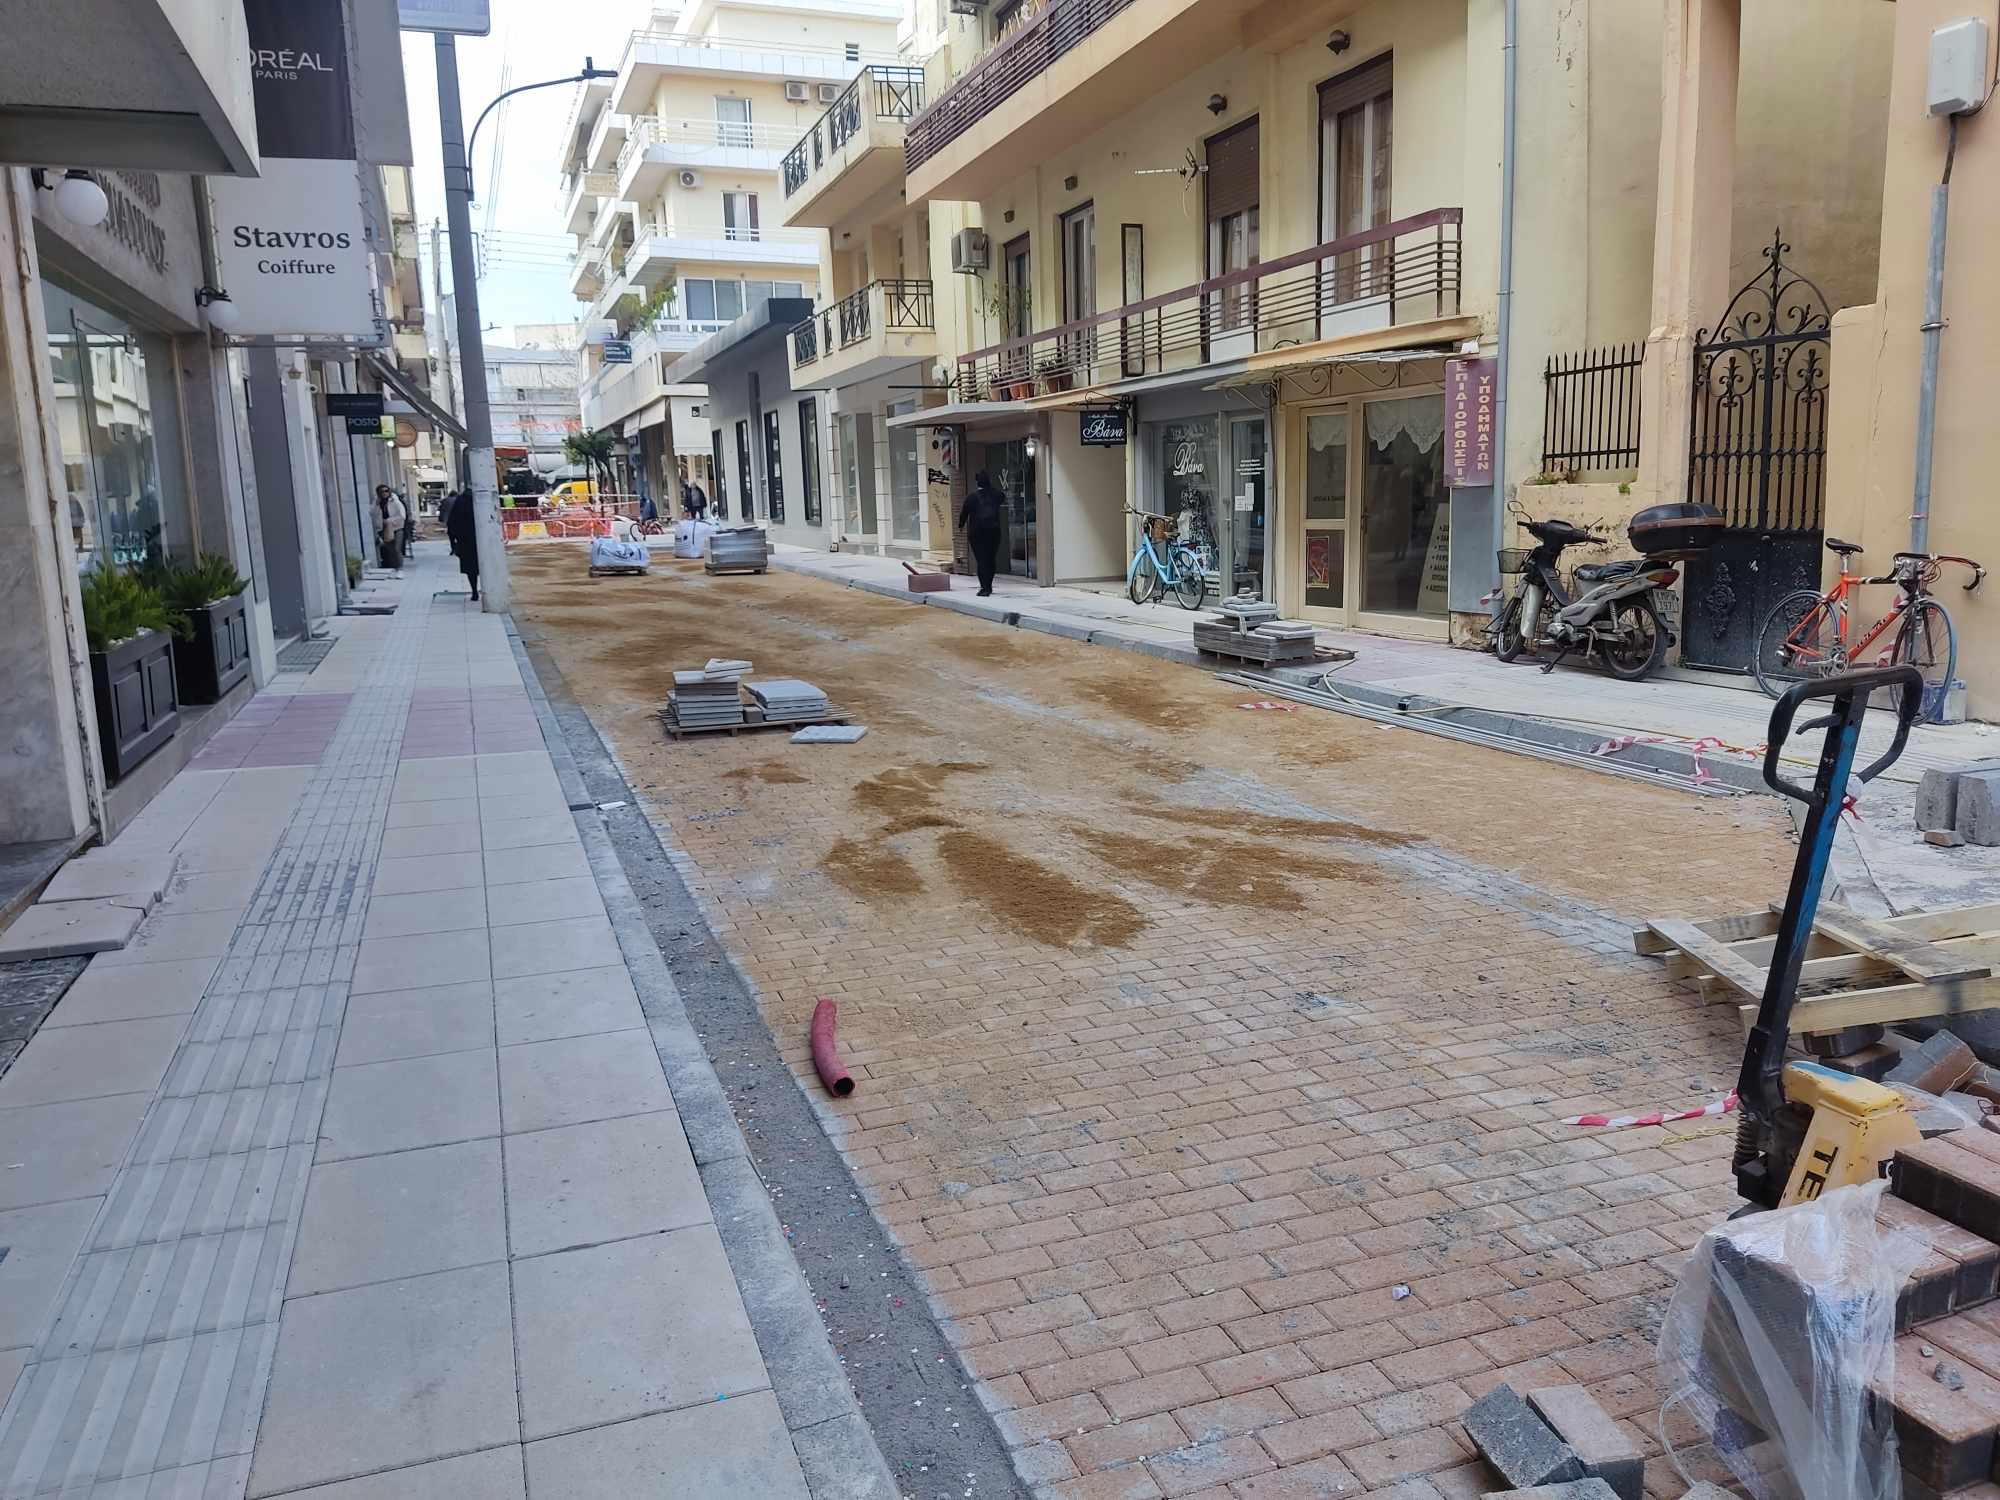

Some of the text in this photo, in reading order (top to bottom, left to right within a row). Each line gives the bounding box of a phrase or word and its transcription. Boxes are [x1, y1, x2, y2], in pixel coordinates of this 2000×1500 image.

[255, 70, 298, 80] PARIS
[233, 225, 350, 249] Stavros
[258, 260, 336, 275] Coiffure
[1477, 375, 1491, 471] ΥΠΟΔΗΜΑΤΩΝ
